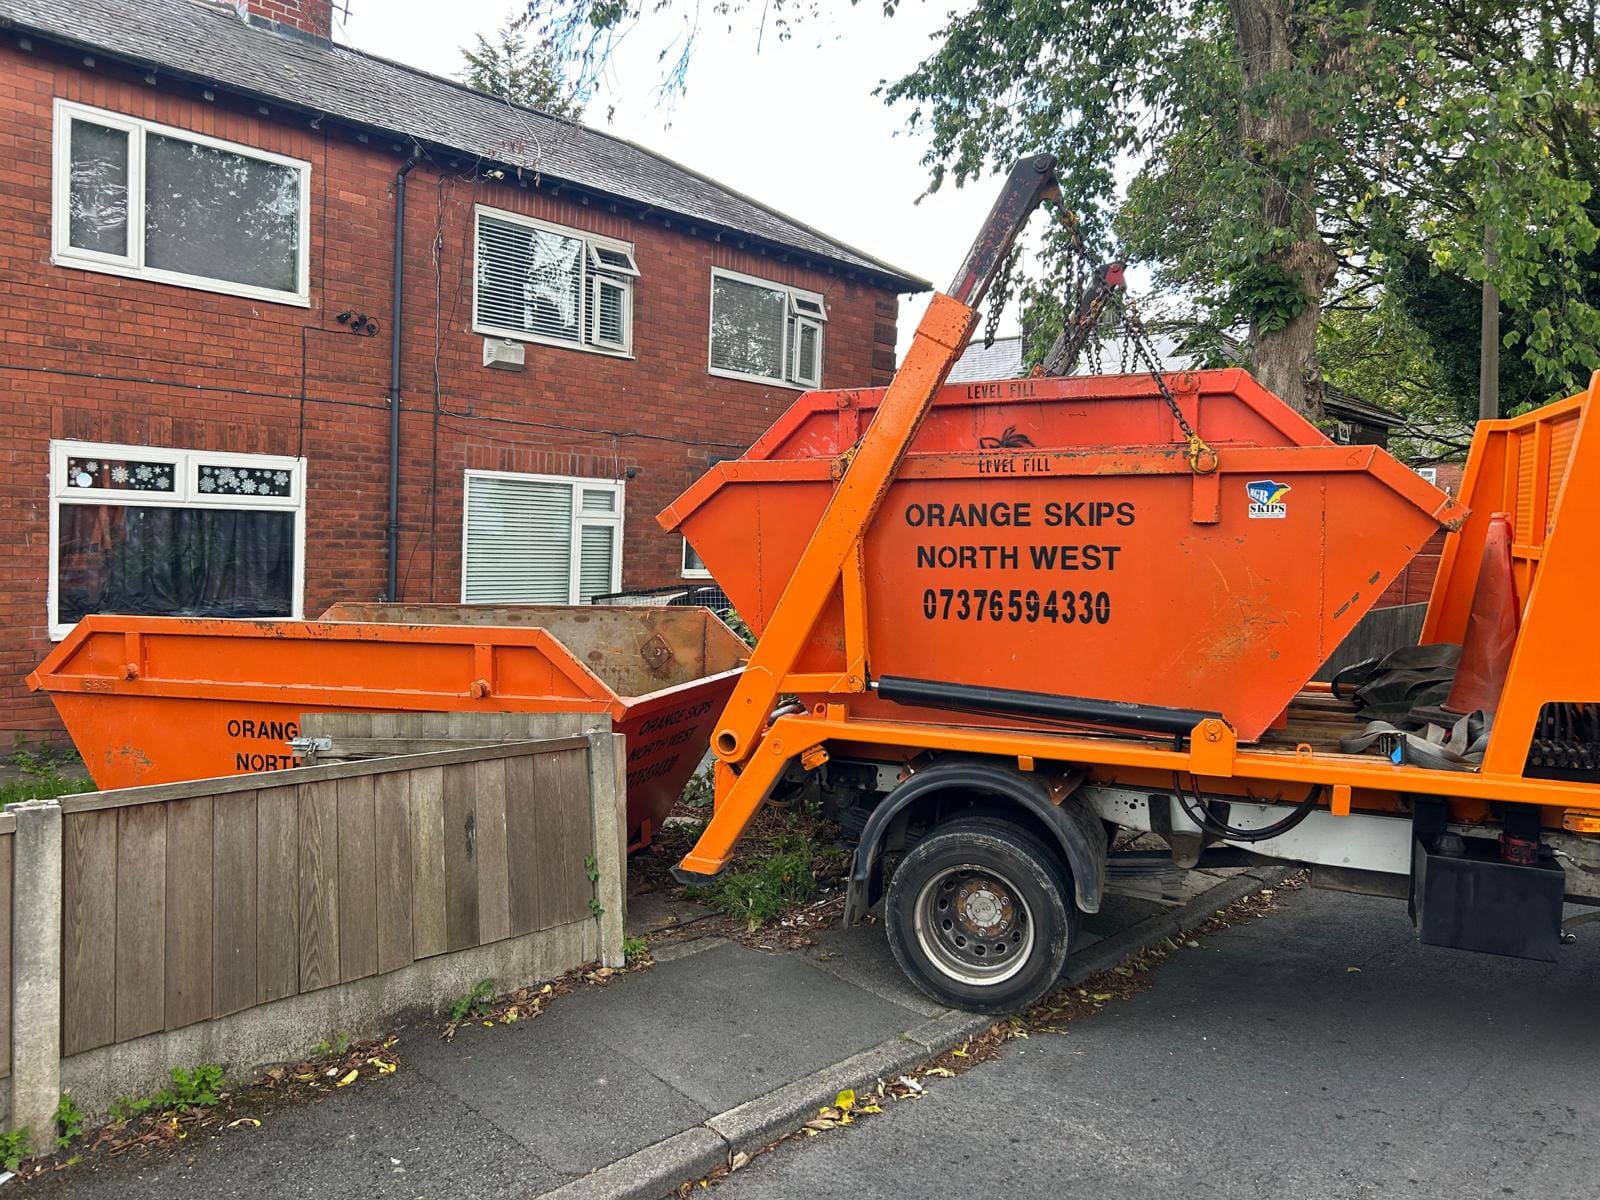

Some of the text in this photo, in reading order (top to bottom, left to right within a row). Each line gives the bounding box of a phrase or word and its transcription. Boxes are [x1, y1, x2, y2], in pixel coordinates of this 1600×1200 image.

[967, 383, 1036, 399] LEVEL FILL
[979, 458, 1050, 473] LEVEL FILL
[906, 503, 1135, 527] ORANGE SKIPS
[1250, 504, 1285, 512] SKIPS
[917, 545, 1121, 571] NORTH WEST
[923, 588, 1111, 625] 07376594330
[227, 719, 300, 742] ORANG
